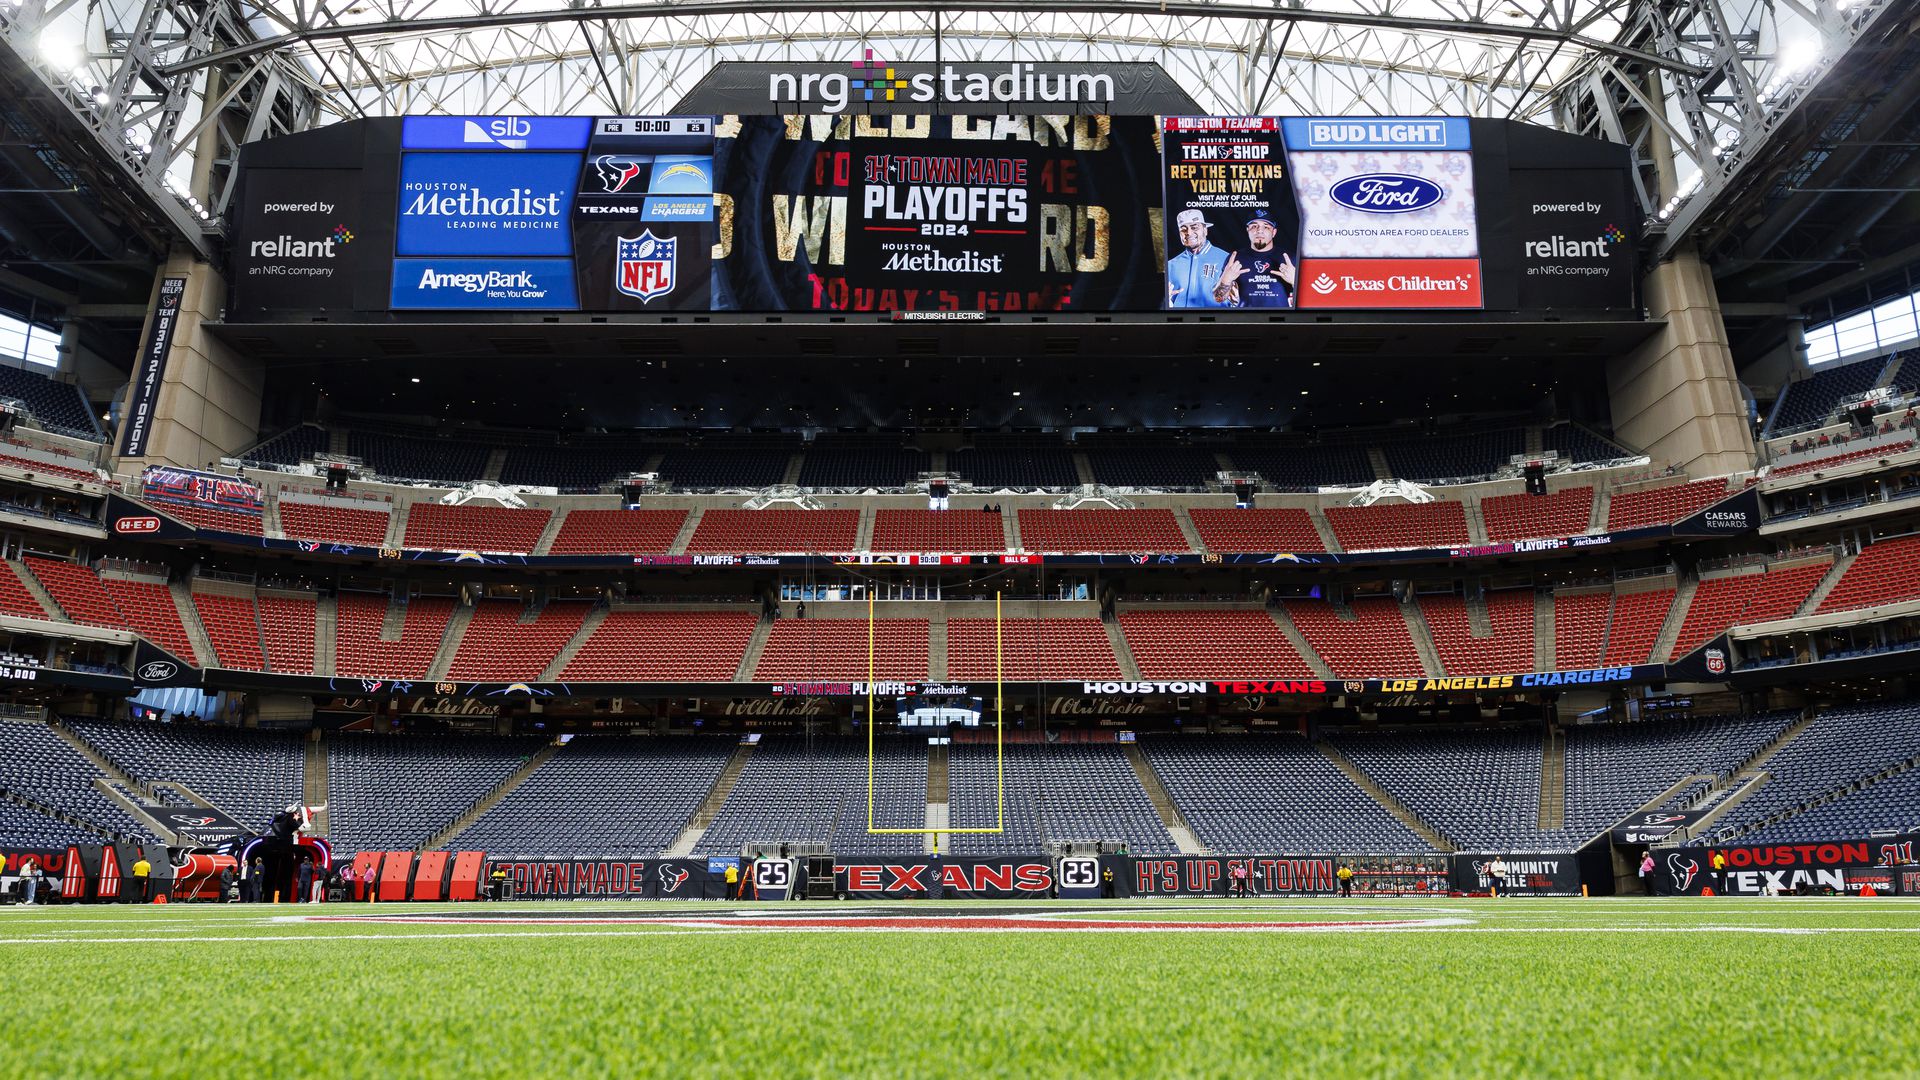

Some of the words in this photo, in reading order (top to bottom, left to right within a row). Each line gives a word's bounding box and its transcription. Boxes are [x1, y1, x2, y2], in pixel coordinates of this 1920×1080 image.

[769, 72, 848, 112] nrg
[911, 63, 1114, 101] stadium
[490, 116, 531, 137] slb
[635, 121, 670, 132] 90:00
[1177, 118, 1222, 128] HOUSTON
[1225, 118, 1262, 128] TEXANS
[1314, 125, 1366, 142] BUD
[1369, 125, 1440, 142] LIGHT
[1182, 146, 1217, 159] TEAM
[1233, 146, 1269, 159] SHOP
[965, 158, 1028, 185] MADE
[1171, 165, 1197, 178] REP
[1201, 165, 1226, 178] THE
[1230, 165, 1282, 178] TEXANS
[405, 182, 467, 191] HOUSTON
[1190, 180, 1226, 193] YOUR
[1231, 180, 1263, 193] WAY!
[1352, 179, 1420, 206] Ford
[264, 202, 317, 214] powered
[319, 202, 334, 214] by
[403, 188, 560, 216] Methodist
[864, 185, 1028, 222] PLAYOFFS
[1532, 202, 1585, 214] powered
[1586, 202, 1601, 214] by
[579, 206, 639, 214] TEXANS
[651, 208, 705, 217] CHARGERS
[447, 221, 497, 229] LEADING
[503, 221, 559, 229] MEDICINE
[921, 223, 969, 236] 2024
[251, 235, 336, 257] reliant
[882, 243, 931, 251] HOUSTON
[1525, 235, 1610, 257] reliant
[882, 249, 1003, 273] Methodist
[249, 267, 261, 275] an
[263, 265, 286, 275] NRG
[288, 267, 333, 277] company
[1527, 267, 1539, 275] an
[1541, 265, 1563, 275] NRG
[1565, 267, 1610, 276] company
[622, 262, 668, 293] NFL
[1341, 275, 1385, 291] Texas
[1387, 275, 1468, 291] Children's
[487, 290, 506, 298] Here,
[506, 290, 521, 298] You
[1705, 512, 1746, 520] CAESARS
[1706, 520, 1748, 528] REWARDS
[1515, 539, 1559, 552] PLAYOFFS
[1573, 536, 1611, 546] Methodist
[694, 556, 734, 565] PLAYOFFS
[746, 557, 780, 565] Methodist
[145, 663, 176, 678] Ford
[1710, 660, 1721, 669] 66
[1381, 680, 1417, 692] LOS
[1424, 676, 1513, 690] ANGELES
[1522, 667, 1632, 687] CHARGERS
[853, 683, 905, 695] PLAYOFFS
[922, 685, 967, 695] Methodist
[1084, 682, 1206, 694] HOUSTON
[1213, 681, 1326, 693] TEXANS
[1640, 833, 1664, 841] Chevr
[1708, 844, 1869, 867] HOUSTON
[760, 864, 786, 884] 25
[1066, 863, 1093, 883] 25
[1504, 861, 1559, 874] MMUNITY
[573, 862, 644, 895] MADE
[1136, 860, 1178, 893] H'S
[1186, 860, 1220, 892] UP
[1259, 860, 1333, 892] TOWN
[1711, 869, 1845, 891] EXAN
